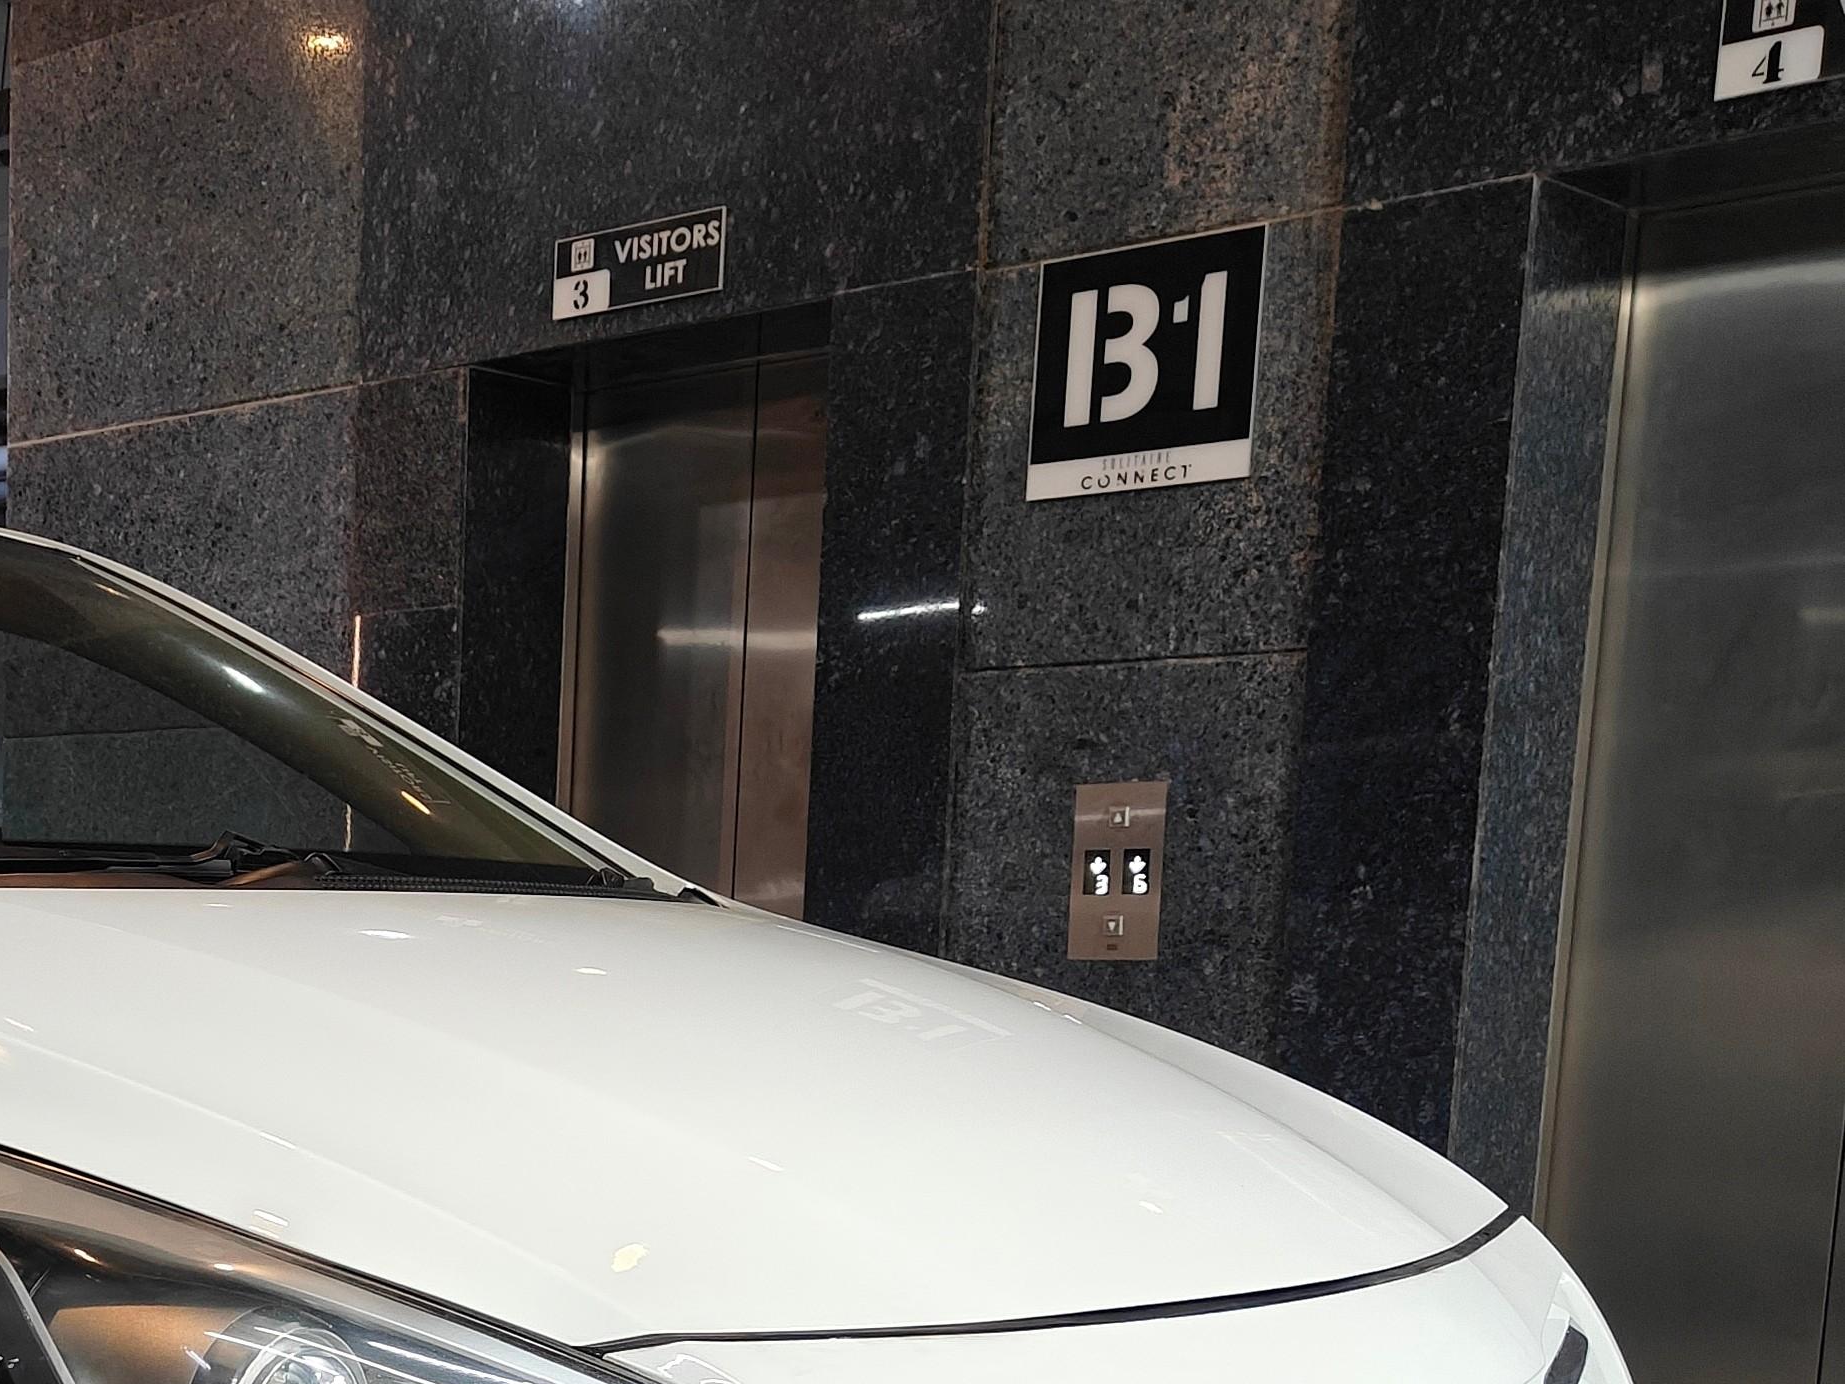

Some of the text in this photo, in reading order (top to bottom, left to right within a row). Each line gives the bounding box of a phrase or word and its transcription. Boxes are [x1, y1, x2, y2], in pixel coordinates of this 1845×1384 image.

[1752, 40, 1784, 84] 4
[614, 220, 720, 263] VISITORS
[645, 258, 687, 290] LIFT
[573, 279, 589, 310] 3
[1063, 270, 1228, 428] B1
[1081, 464, 1189, 490] CONNECT
